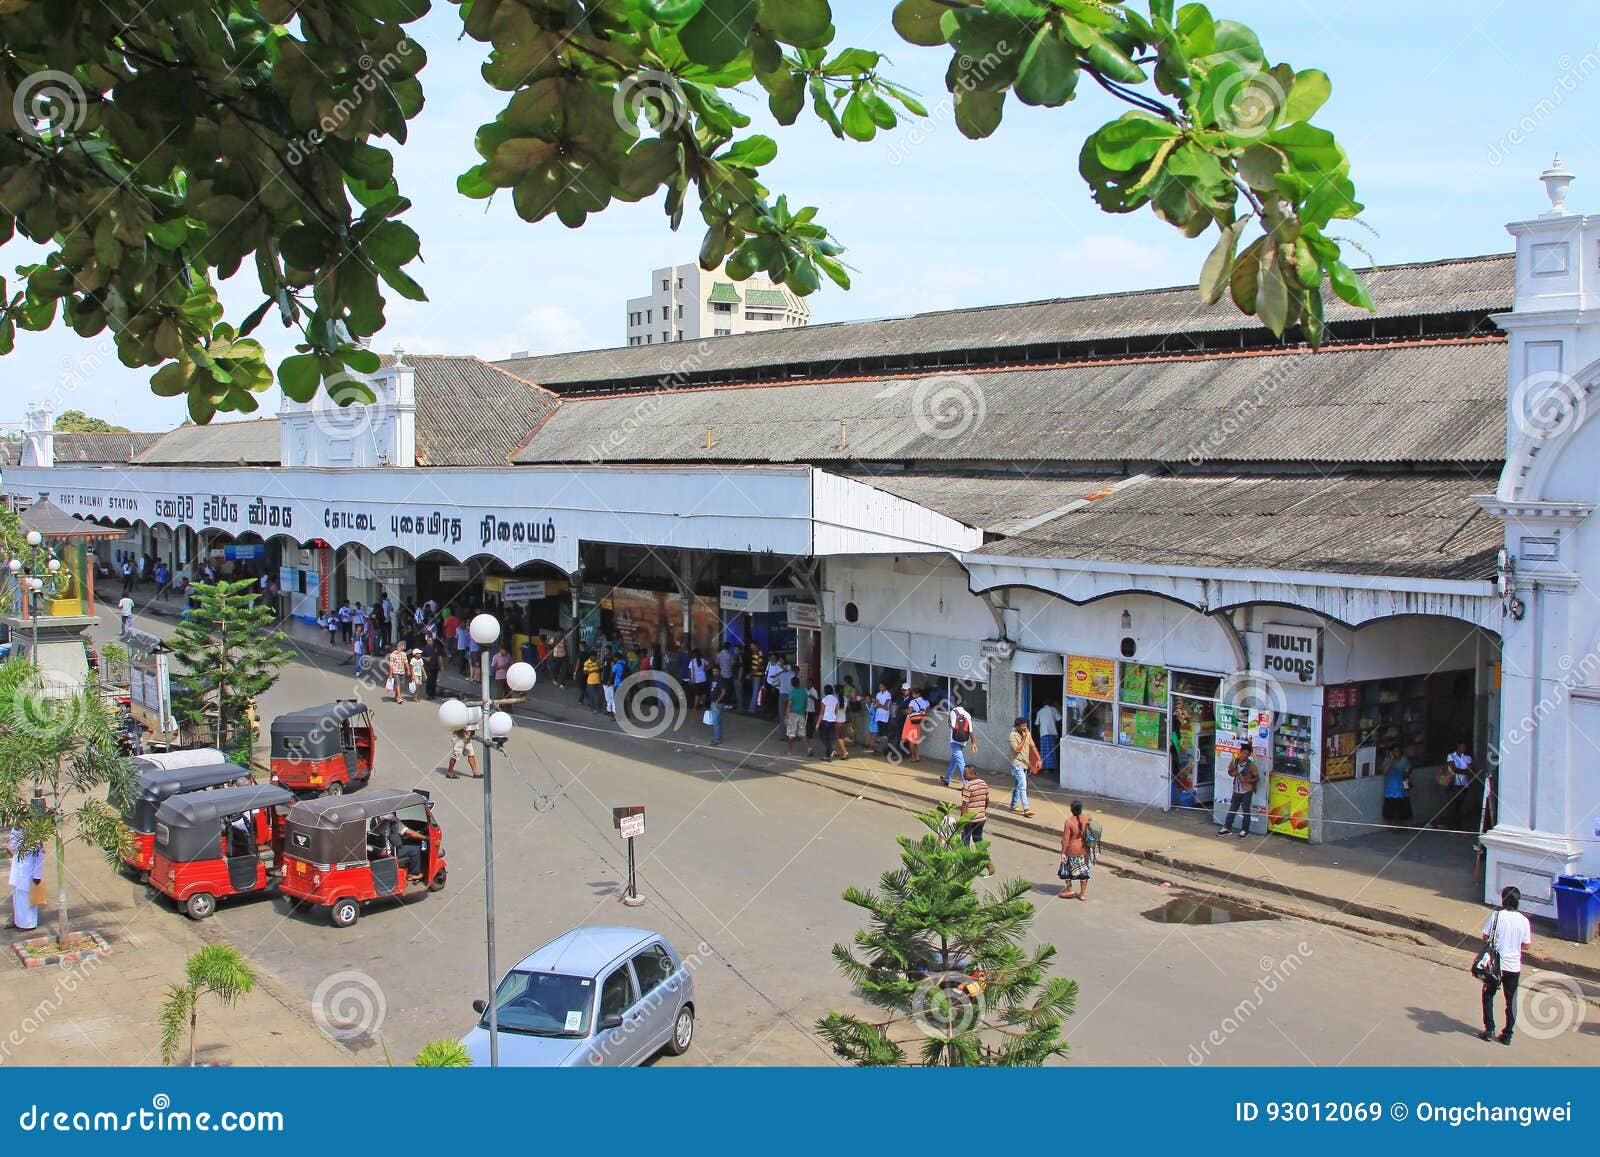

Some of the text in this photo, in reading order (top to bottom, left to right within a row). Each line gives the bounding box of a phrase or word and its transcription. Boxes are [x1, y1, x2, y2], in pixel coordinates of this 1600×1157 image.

[60, 494, 138, 511] FORT RAILWAY STATION
[324, 508, 556, 547] கோட்டை புகையிரத நிலையம்
[1267, 633, 1312, 653] MULTI
[1264, 655, 1315, 675] FOODS
